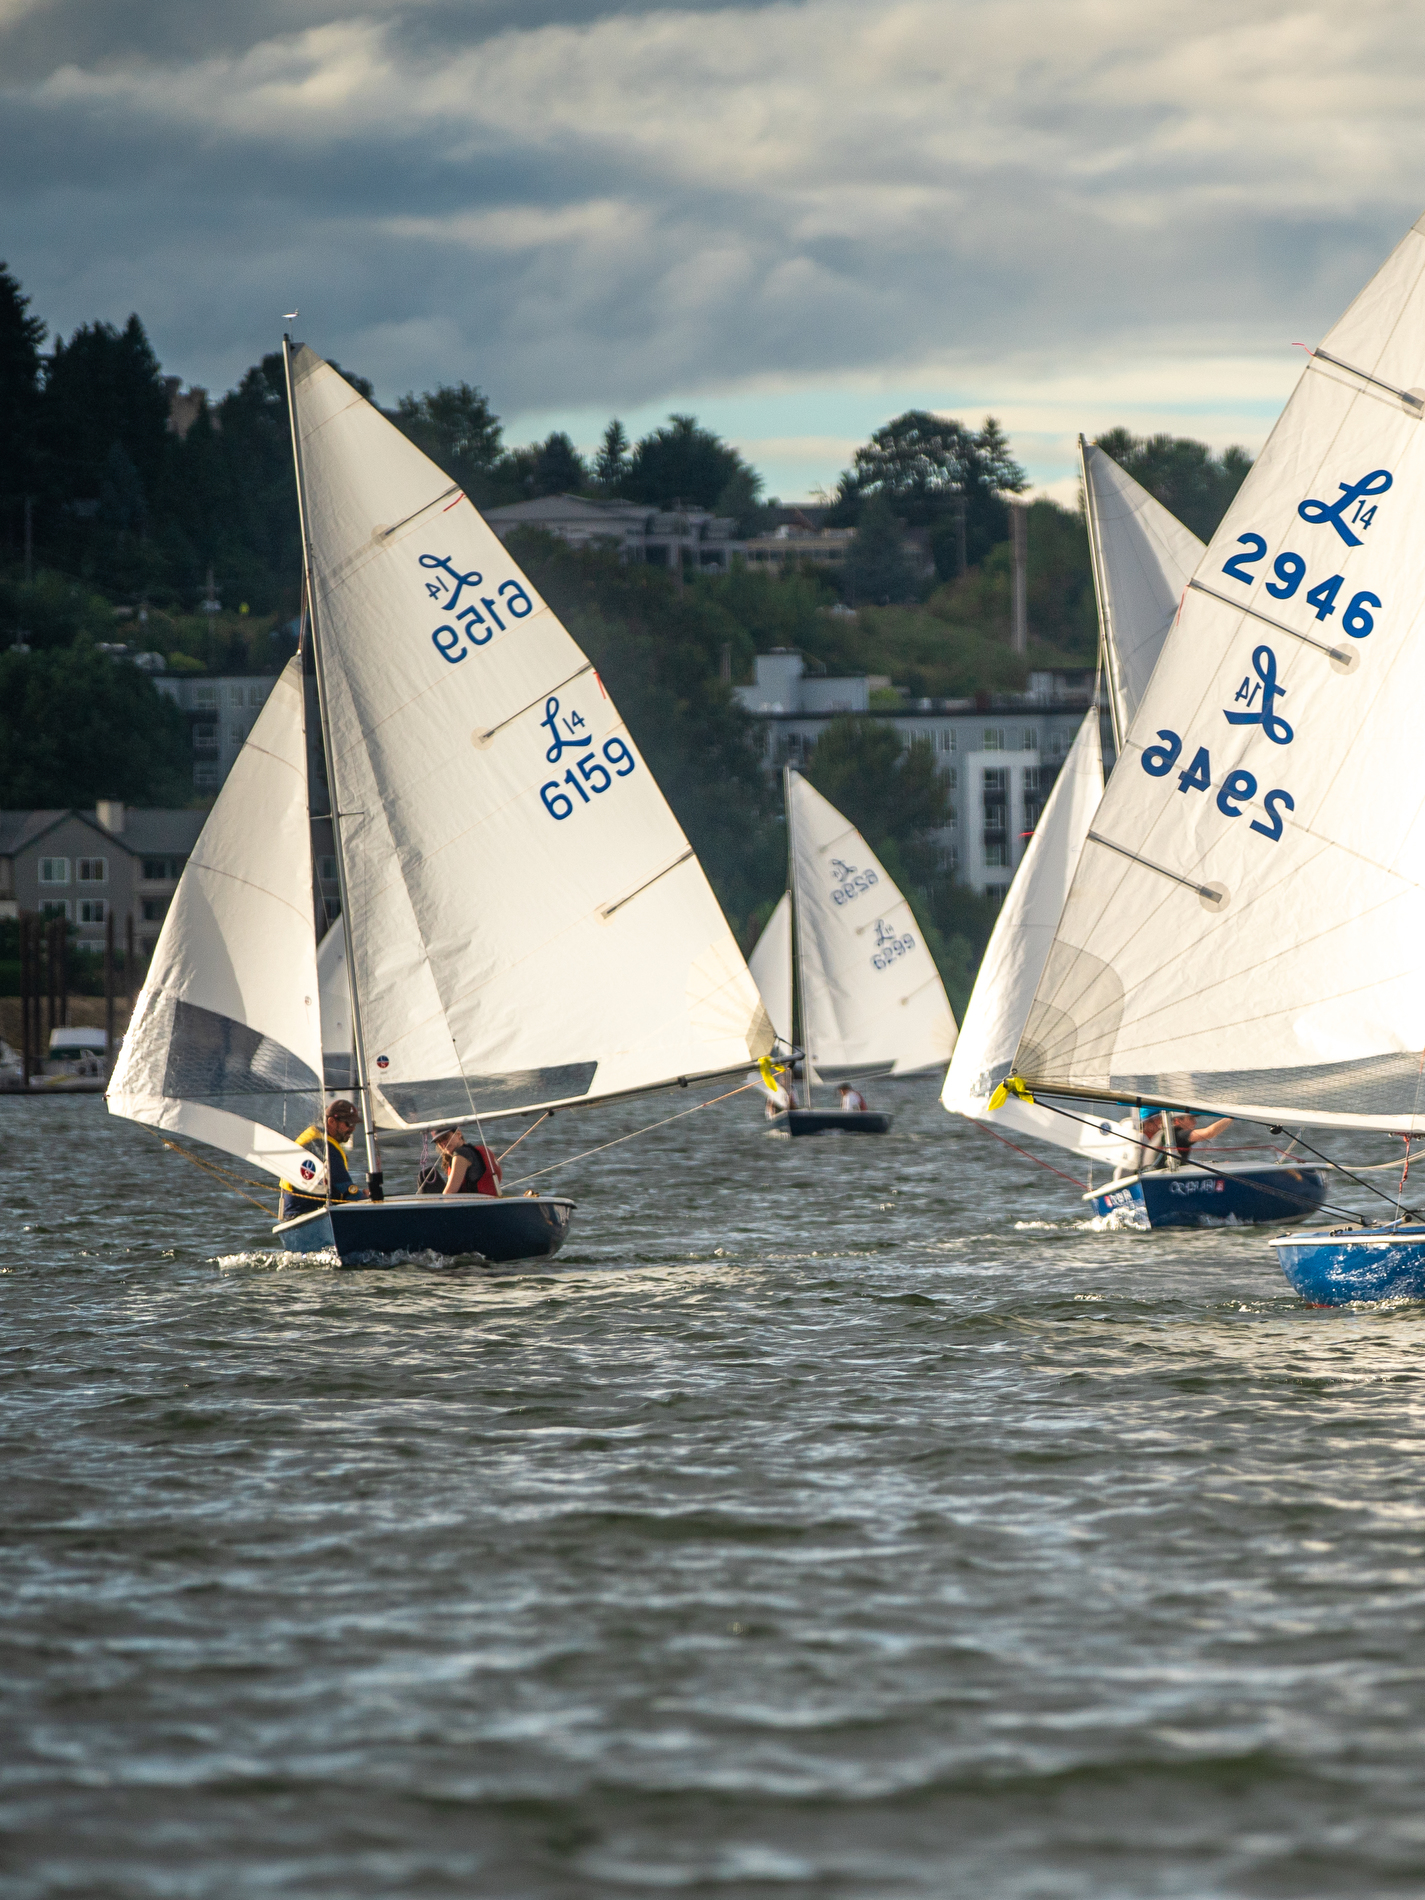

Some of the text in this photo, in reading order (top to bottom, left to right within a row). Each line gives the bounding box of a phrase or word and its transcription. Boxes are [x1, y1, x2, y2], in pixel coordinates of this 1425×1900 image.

[1351, 500, 1378, 530] 14
[1221, 532, 1382, 639] 2946
[562, 710, 586, 734] 14
[539, 737, 635, 820] 6159
